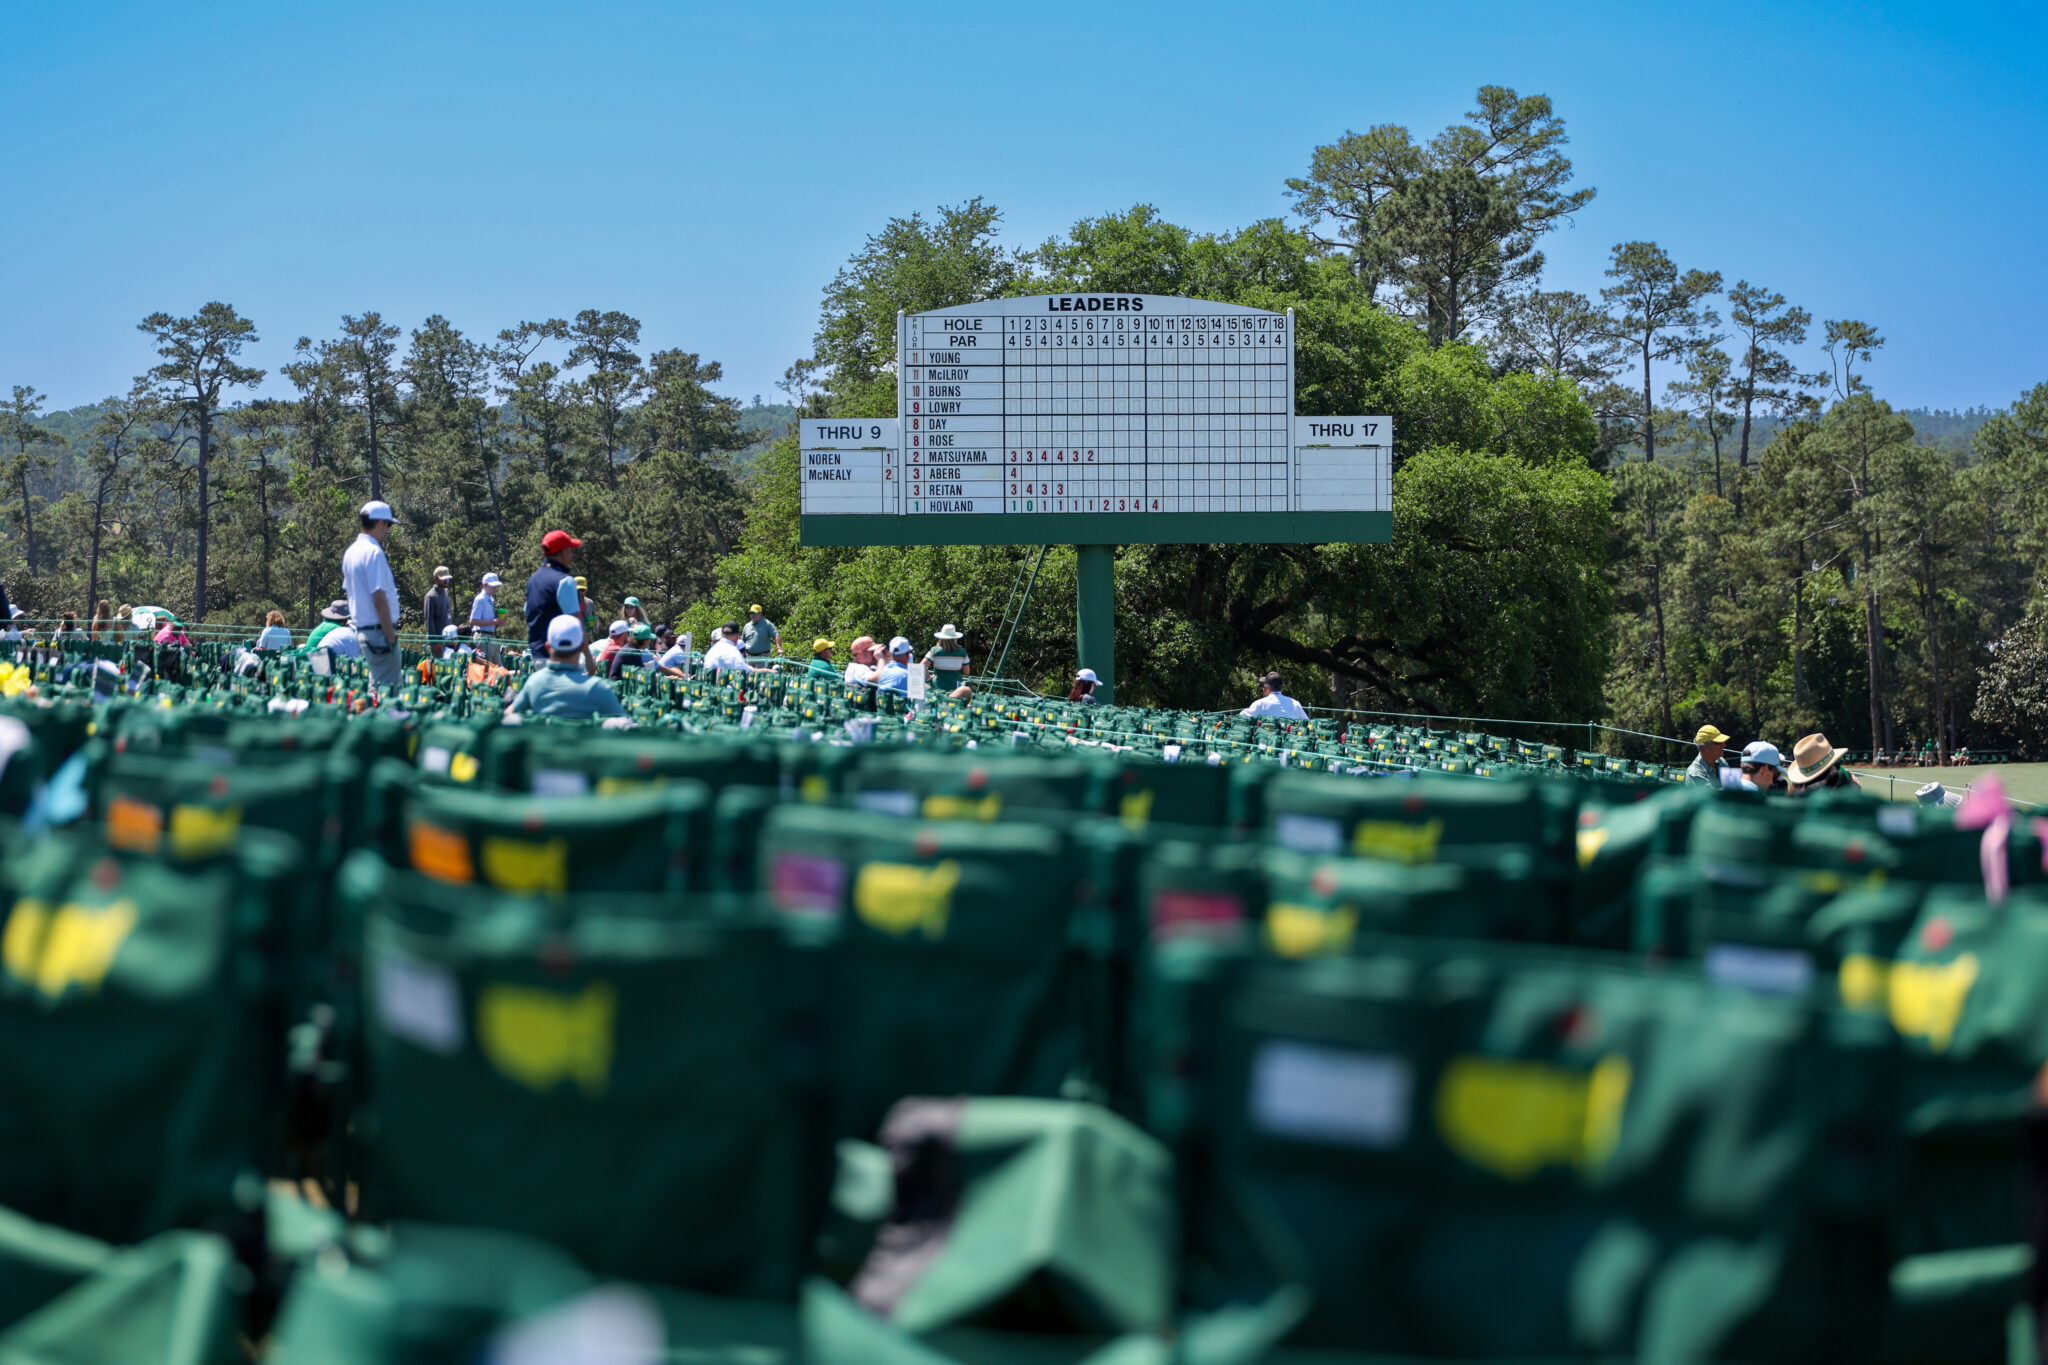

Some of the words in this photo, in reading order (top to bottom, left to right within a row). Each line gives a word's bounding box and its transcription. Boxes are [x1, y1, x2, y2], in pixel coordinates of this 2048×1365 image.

[1049, 297, 1143, 311] LEADERS
[944, 319, 982, 331] HOLE
[1025, 319, 1031, 330] 2
[1040, 319, 1047, 330] 3
[1056, 319, 1062, 330] 4
[1072, 319, 1078, 330] 5
[1087, 318, 1093, 330] 6
[1102, 318, 1108, 329] 7
[1117, 318, 1123, 330] 8
[1134, 318, 1140, 330] 9
[1149, 318, 1160, 330] 10
[1166, 319, 1174, 329] 11
[1181, 318, 1191, 329] 12
[1196, 318, 1206, 329] 13
[1211, 318, 1221, 329] 14
[1227, 318, 1237, 329] 15
[1242, 318, 1253, 329] 16
[1257, 318, 1267, 329] 17
[1273, 318, 1284, 329] 18
[950, 336, 976, 347] PAR
[1009, 336, 1015, 346] 4
[1025, 335, 1031, 346] 5
[1041, 335, 1047, 346] 4
[1056, 335, 1063, 346] 3
[1071, 335, 1078, 346] 4
[1087, 335, 1094, 346] 3
[1102, 335, 1109, 346] 4
[1118, 335, 1124, 346] 5
[1134, 335, 1140, 345] 4
[1151, 335, 1157, 345] 4
[1167, 335, 1173, 345] 4
[1183, 334, 1189, 346] 3
[1198, 335, 1204, 346] 5
[1213, 335, 1220, 345] 4
[1229, 334, 1235, 346] 5
[1244, 334, 1250, 346] 3
[1259, 334, 1266, 345] 4
[1275, 334, 1281, 345] 4
[929, 352, 960, 363] YOUNG
[929, 369, 969, 380] McILROY
[913, 385, 920, 397] 10
[929, 386, 961, 397] BURNS
[913, 402, 919, 413] 9
[929, 402, 961, 413] LOWRY
[913, 419, 919, 430] 8
[929, 419, 946, 430] DAY
[1309, 424, 1353, 437] THRU
[1362, 424, 1378, 436] 17
[817, 426, 862, 439] THRU
[871, 426, 881, 439] 9
[914, 436, 919, 446] 8
[929, 435, 954, 446] ROSE
[809, 454, 840, 465] NOREN
[913, 451, 919, 462] 2
[929, 451, 987, 462] MATSUYAMA
[1011, 451, 1017, 462] 3
[1027, 451, 1032, 462] 3
[1041, 451, 1047, 461] 4
[1057, 451, 1063, 462] 4
[1073, 451, 1079, 462] 3
[1088, 450, 1094, 461] 2
[809, 469, 851, 480] McNEALY
[886, 469, 891, 480] 2
[913, 468, 919, 479] 3
[930, 468, 960, 479] ABERG
[1011, 468, 1016, 478] 4
[914, 485, 920, 496] 3
[929, 485, 962, 496] REITAN
[1011, 484, 1017, 495] 3
[1026, 484, 1032, 495] 4
[1042, 484, 1047, 495] 3
[1057, 484, 1063, 495] 3
[930, 501, 973, 512] HOVLAND
[1027, 500, 1033, 511] 0
[1104, 500, 1109, 511] 2
[1119, 499, 1125, 511] 3
[1134, 500, 1140, 510] 4
[1152, 500, 1158, 510] 4
